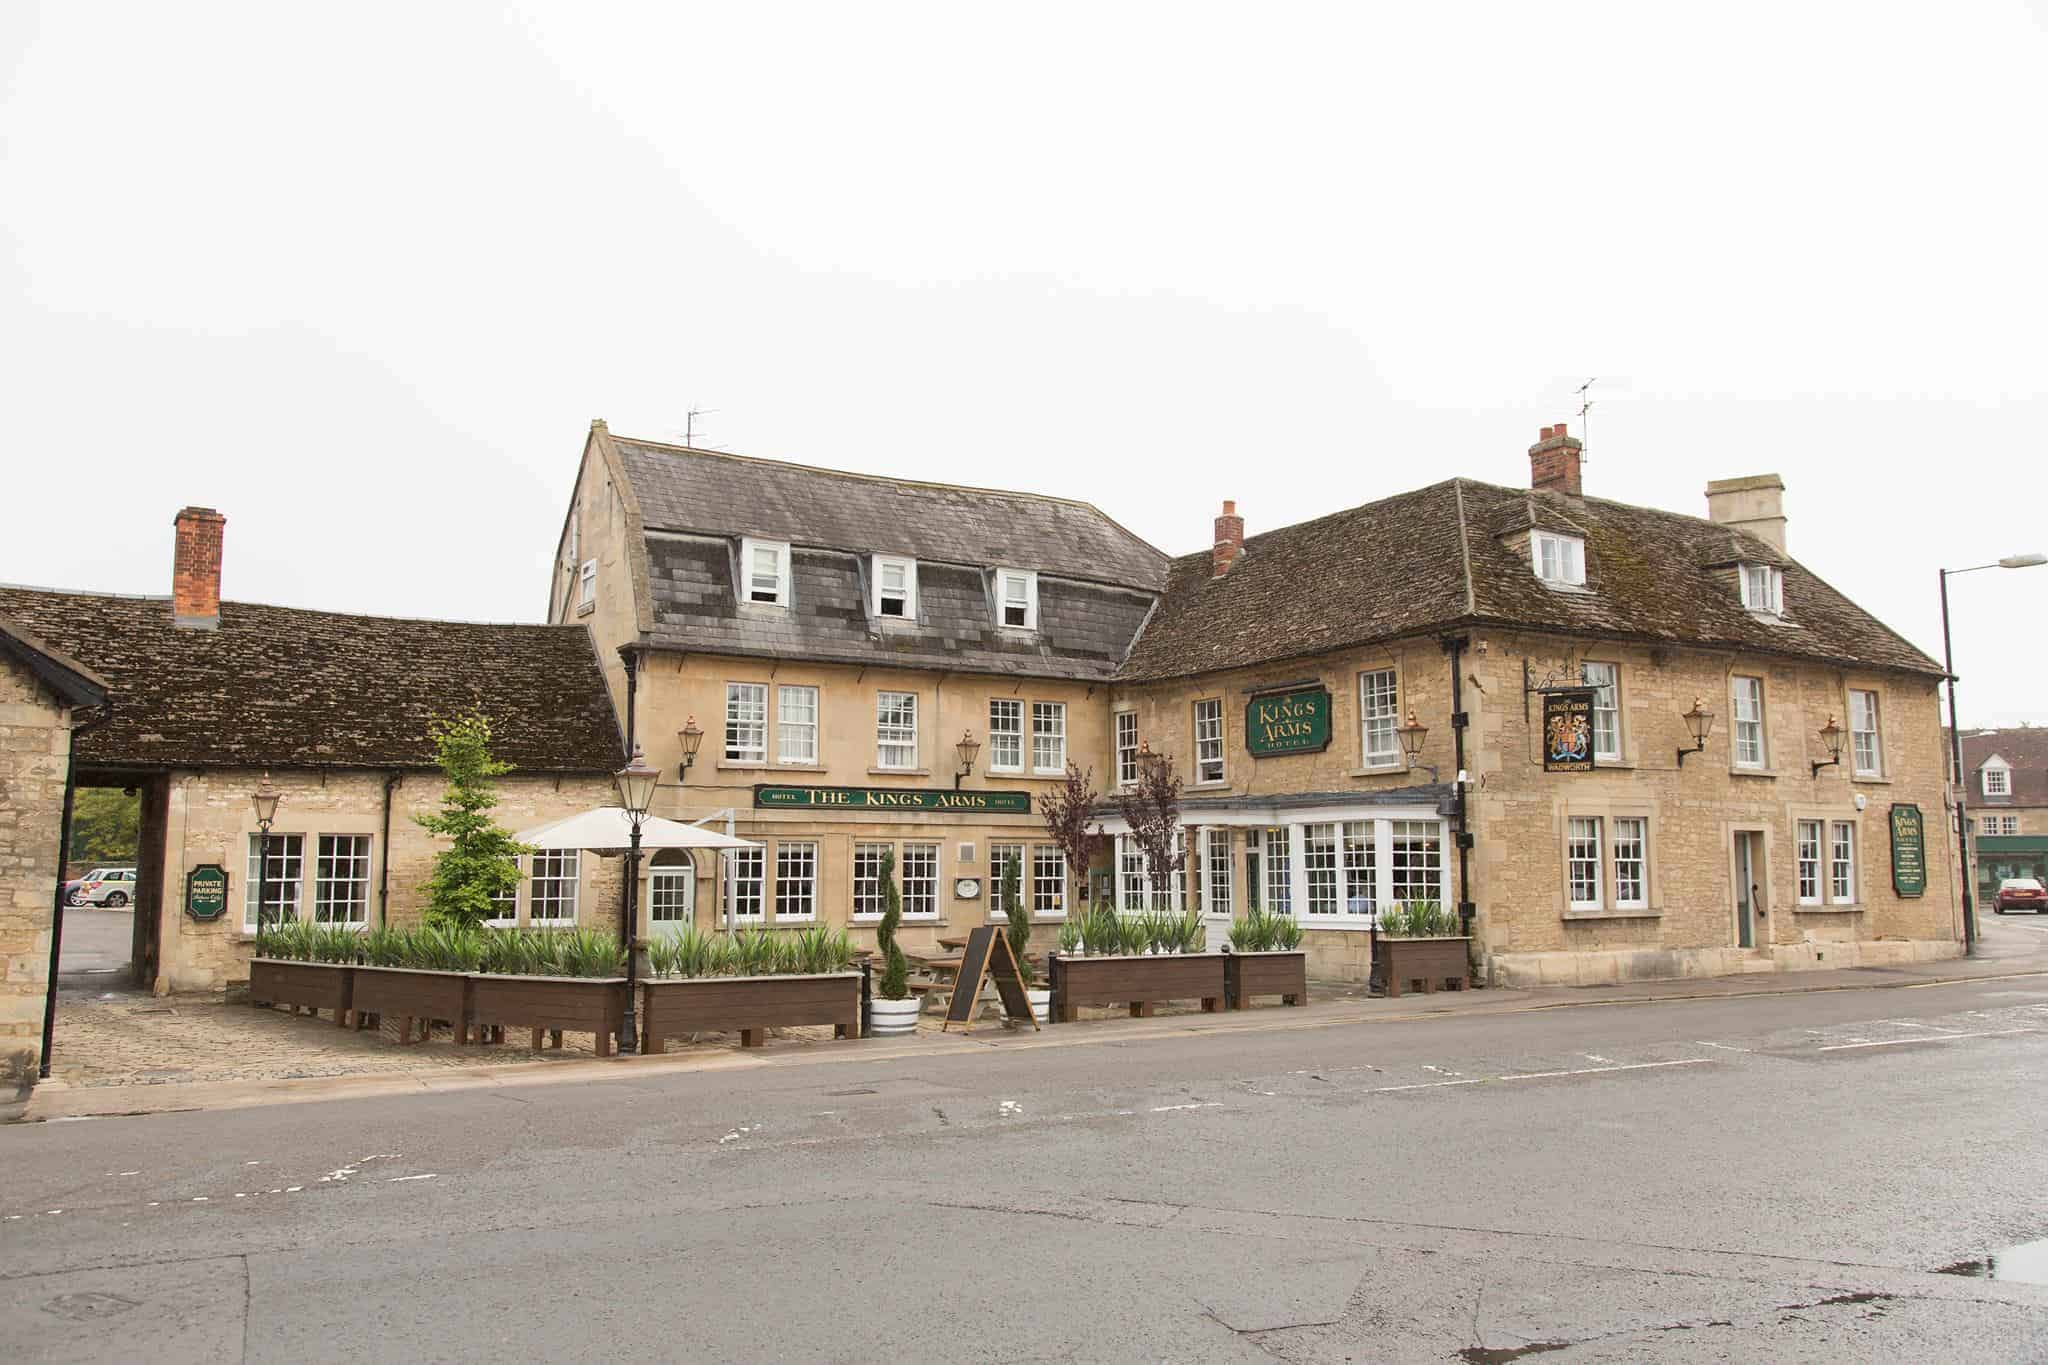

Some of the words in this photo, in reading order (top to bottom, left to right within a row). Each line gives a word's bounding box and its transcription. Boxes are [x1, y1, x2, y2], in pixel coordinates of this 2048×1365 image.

[1260, 702, 1315, 725] KINGS
[1549, 703, 1569, 712] KINGS
[1570, 703, 1589, 712] ARMS
[1260, 720, 1312, 743] ARMS
[1267, 739, 1310, 749] HOTEL
[771, 791, 796, 800] HOTEL
[804, 788, 850, 804] THE
[866, 791, 923, 805] KINGS
[935, 793, 986, 807] ARMS
[1895, 815, 1918, 827] KINGS
[1896, 826, 1918, 838] ARMS
[193, 887, 223, 895] PARKING
